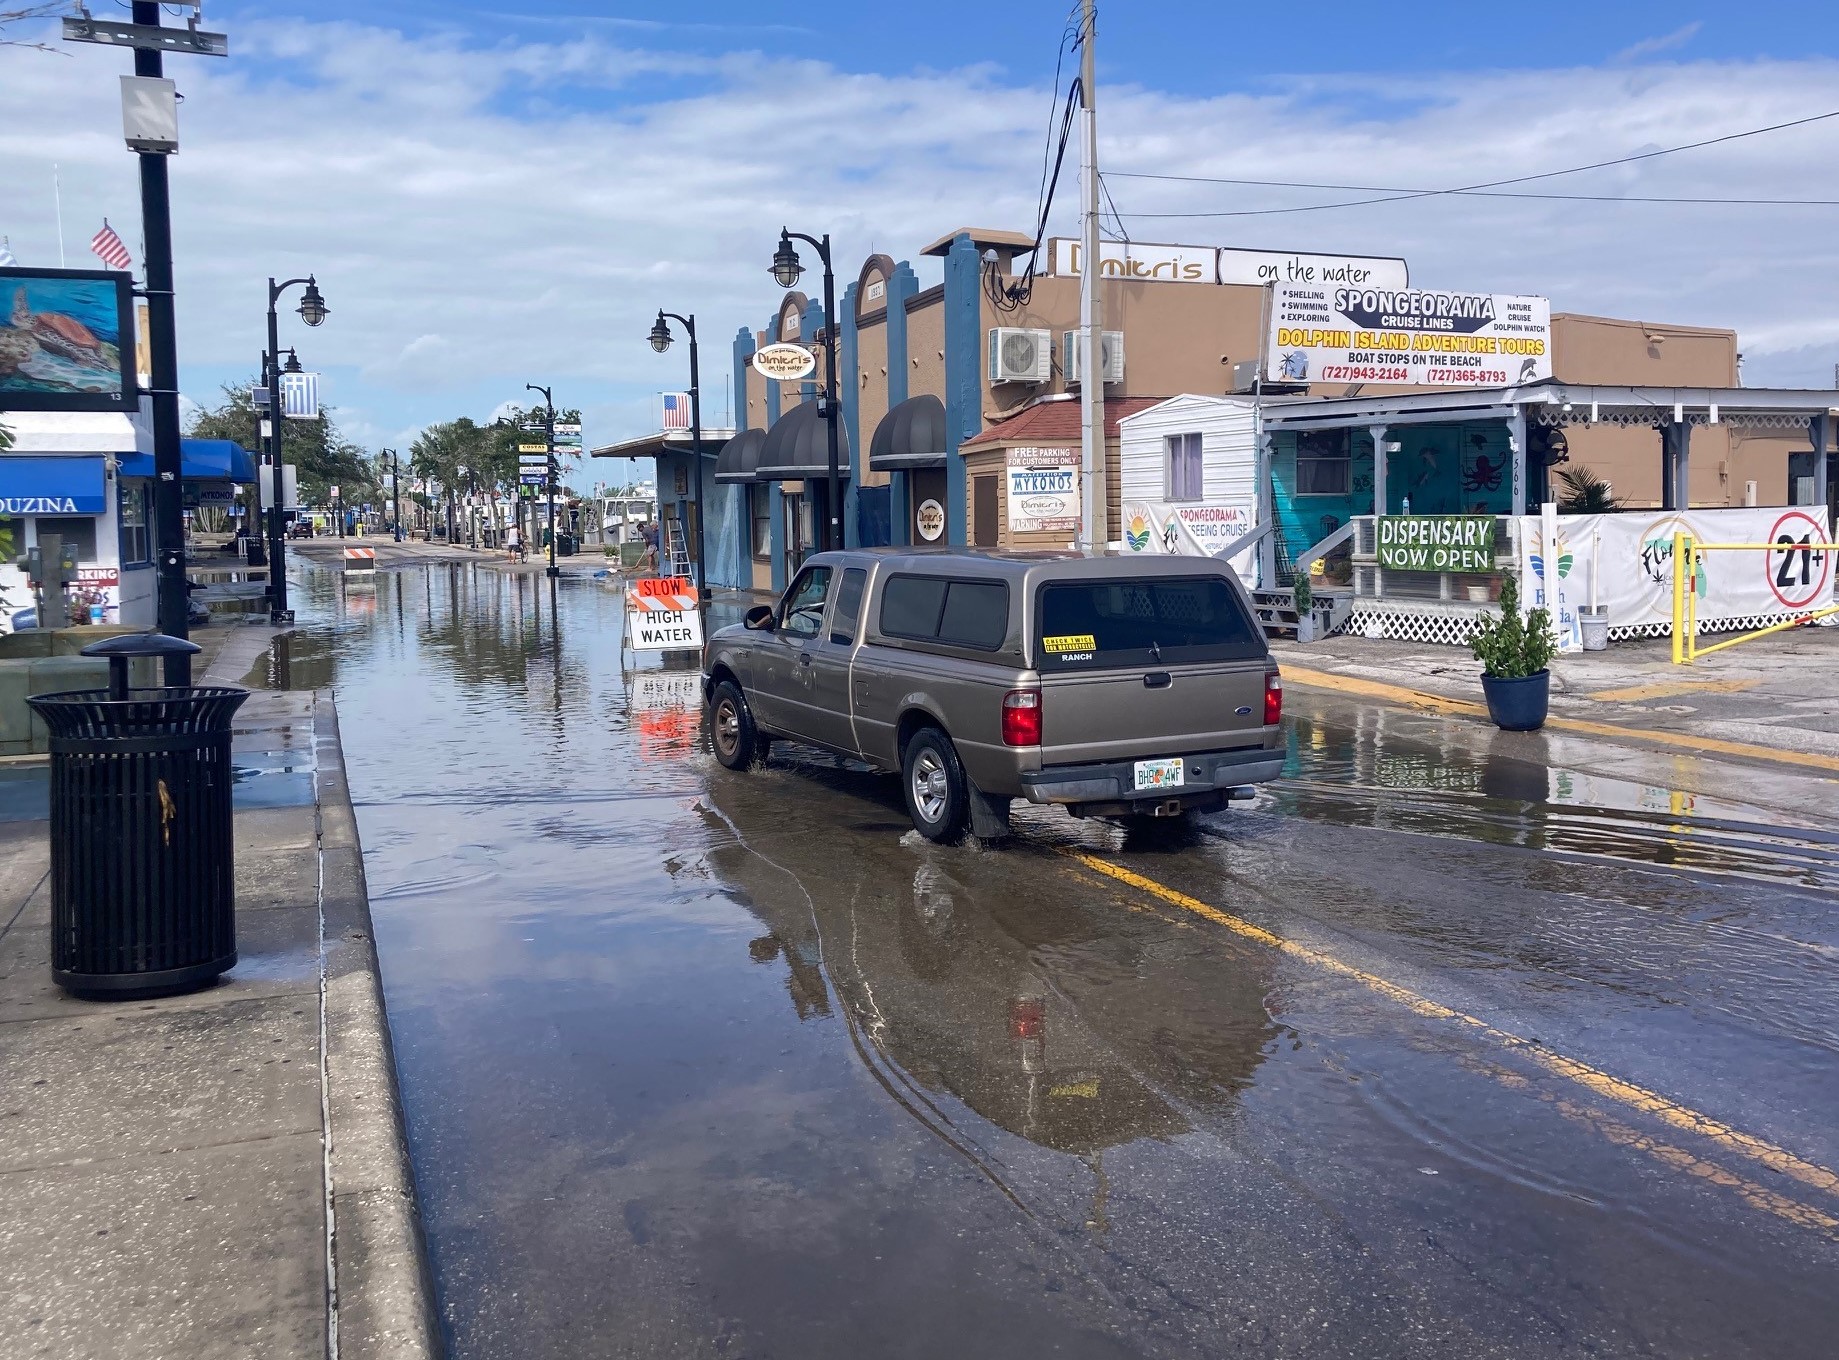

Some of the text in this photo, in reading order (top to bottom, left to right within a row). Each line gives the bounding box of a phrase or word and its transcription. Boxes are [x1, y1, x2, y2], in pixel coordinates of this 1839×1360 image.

[1071, 243, 1203, 280] Dmitri's
[1257, 257, 1372, 286] on the water
[1288, 290, 1325, 300] SHELLING
[1287, 301, 1329, 311] SWIMMING
[1335, 288, 1496, 319] SPONGEORAMA
[1507, 303, 1532, 312] NATURE
[1287, 313, 1330, 323] EXPLORING
[1381, 315, 1454, 330] CRUISE LINES
[1508, 313, 1532, 322] CRUISE
[1493, 323, 1546, 333] DOLPHIN WATCH
[1278, 328, 1545, 355] DOLPHIN ISLAND ADVENTURE TOURS
[1348, 352, 1482, 367] BOAT STOPS ON THE BEACH
[1322, 366, 1507, 384] (727)943-2164 (727)365-8793
[111, 393, 122, 401] 13
[1014, 447, 1071, 457] FREE PARKING
[1008, 458, 1021, 466] FOR
[1022, 457, 1059, 466] CUSTOMERS
[1014, 476, 1072, 491] MYKONOS
[200, 490, 234, 499] MYKONOS
[1180, 508, 1238, 522] SPONGEORAMA
[1009, 518, 1043, 531] WARNING
[1188, 523, 1248, 537] SEEING CRUISE
[1381, 520, 1490, 546] DISPENSARY
[1381, 548, 1489, 568] NOW OPEN
[78, 569, 118, 580] RKING
[643, 580, 681, 596] SLOW
[646, 611, 683, 624] HIGH
[641, 628, 692, 643] WATER
[1062, 653, 1093, 661] RANCH
